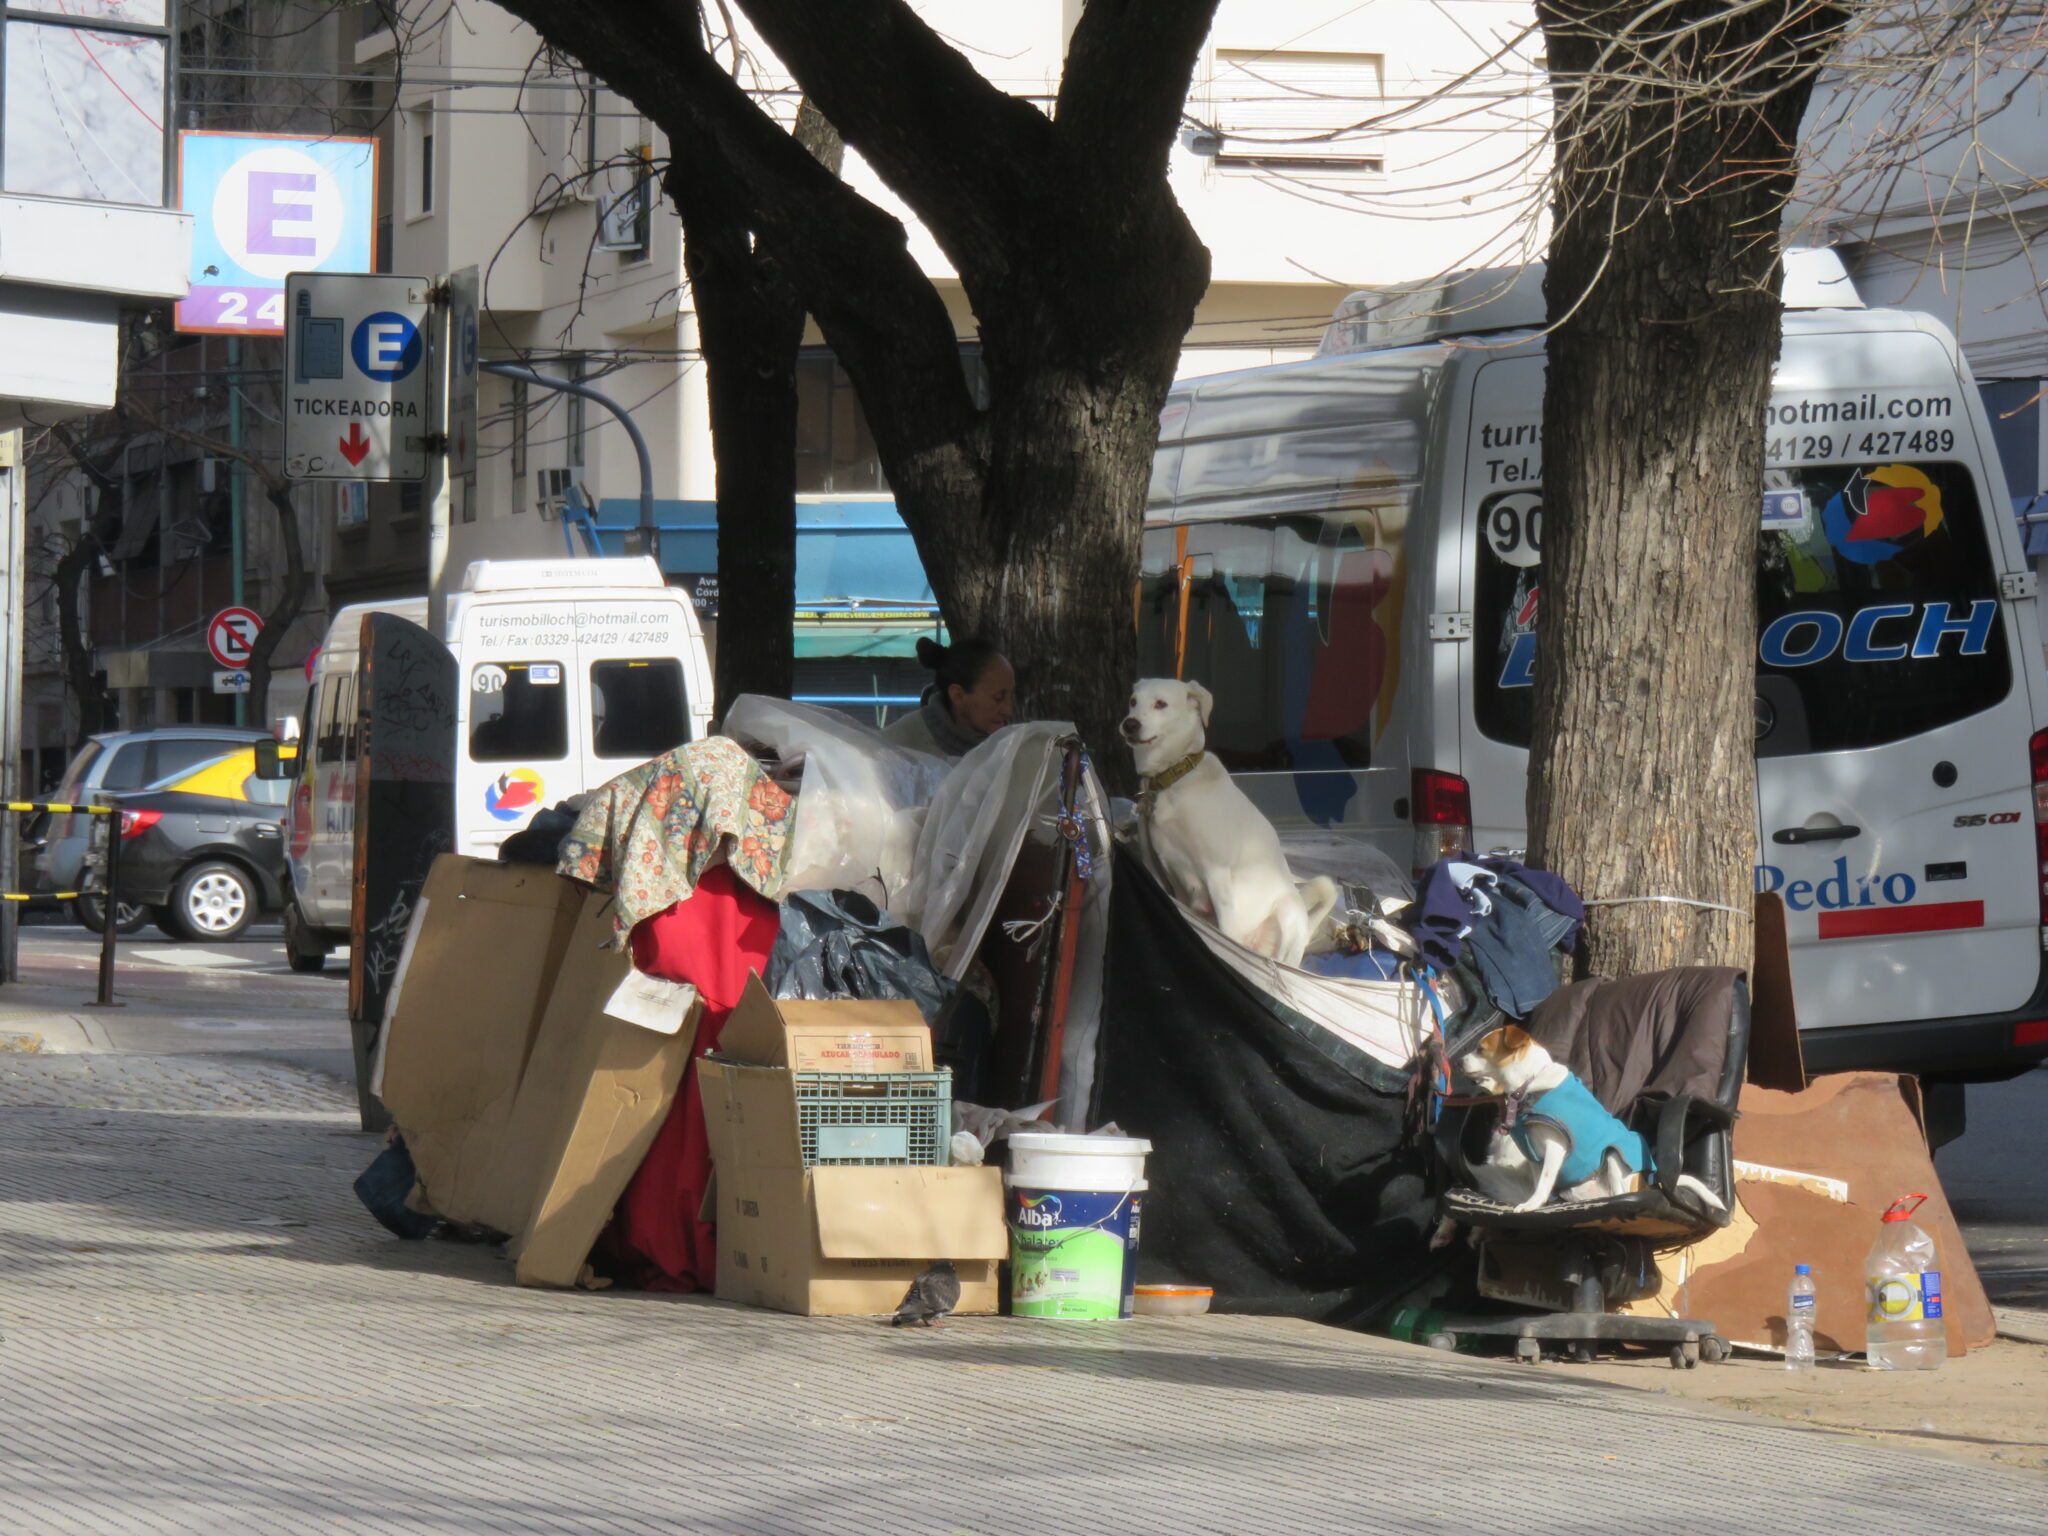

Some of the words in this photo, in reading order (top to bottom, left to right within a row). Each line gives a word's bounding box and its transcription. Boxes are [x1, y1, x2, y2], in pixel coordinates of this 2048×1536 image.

[246, 170, 316, 257] E
[216, 291, 285, 326] 24
[367, 323, 404, 371] E
[294, 398, 418, 417] TICKEADORA
[1767, 434, 1833, 461] 4129
[1840, 433, 1852, 458] /
[1858, 429, 1954, 456] 427489
[1492, 505, 1542, 553] 90
[480, 611, 669, 628] turismobilloch@hotmail.com
[1759, 600, 1997, 667] OCH
[534, 633, 569, 646] 03329
[577, 632, 618, 645] 424129
[628, 631, 669, 644] 427489
[478, 673, 502, 692] 90
[1754, 855, 1916, 911] Pedro
[1018, 1207, 1053, 1227] Alba
